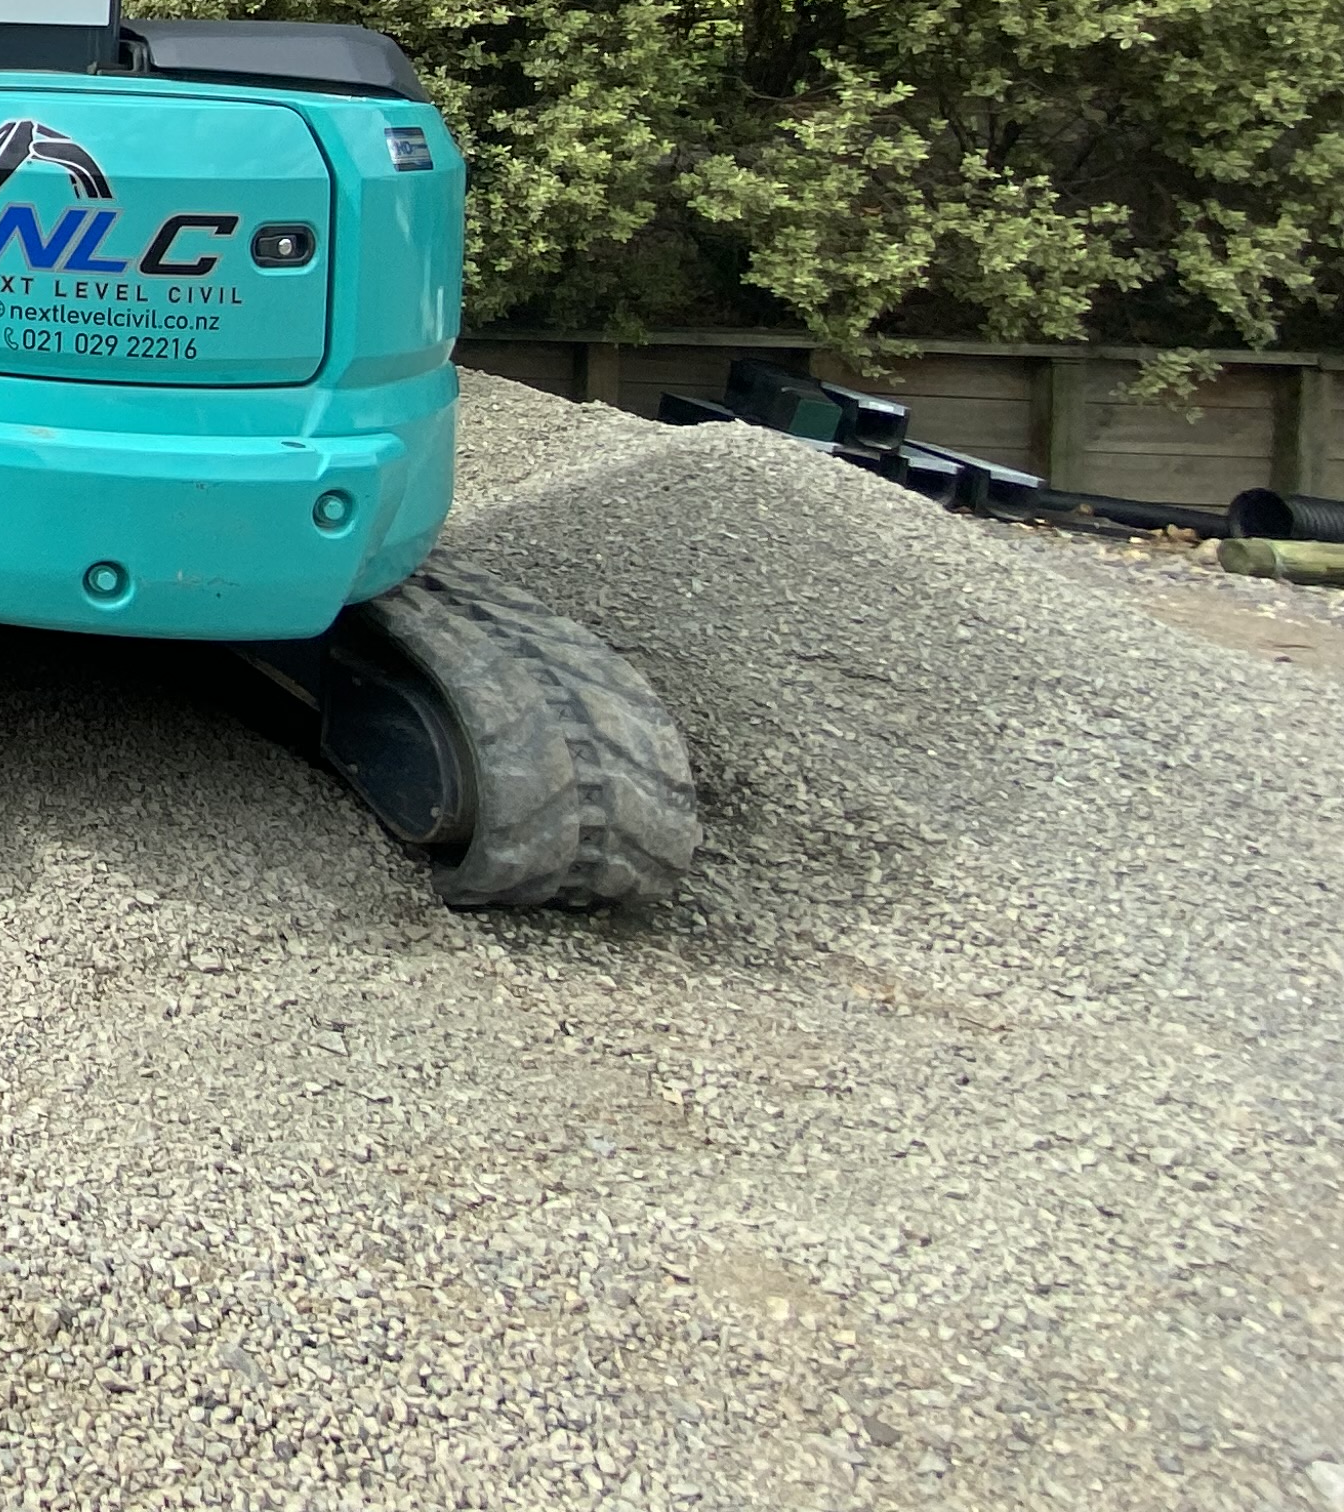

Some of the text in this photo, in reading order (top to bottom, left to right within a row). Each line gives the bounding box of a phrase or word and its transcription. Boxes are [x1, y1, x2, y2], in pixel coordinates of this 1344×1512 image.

[55, 280, 148, 302] LEVEL
[168, 286, 242, 304] CIVIL
[10, 304, 220, 331] nextlevelcivil.co.nz
[23, 329, 198, 360] 021 029 22216
